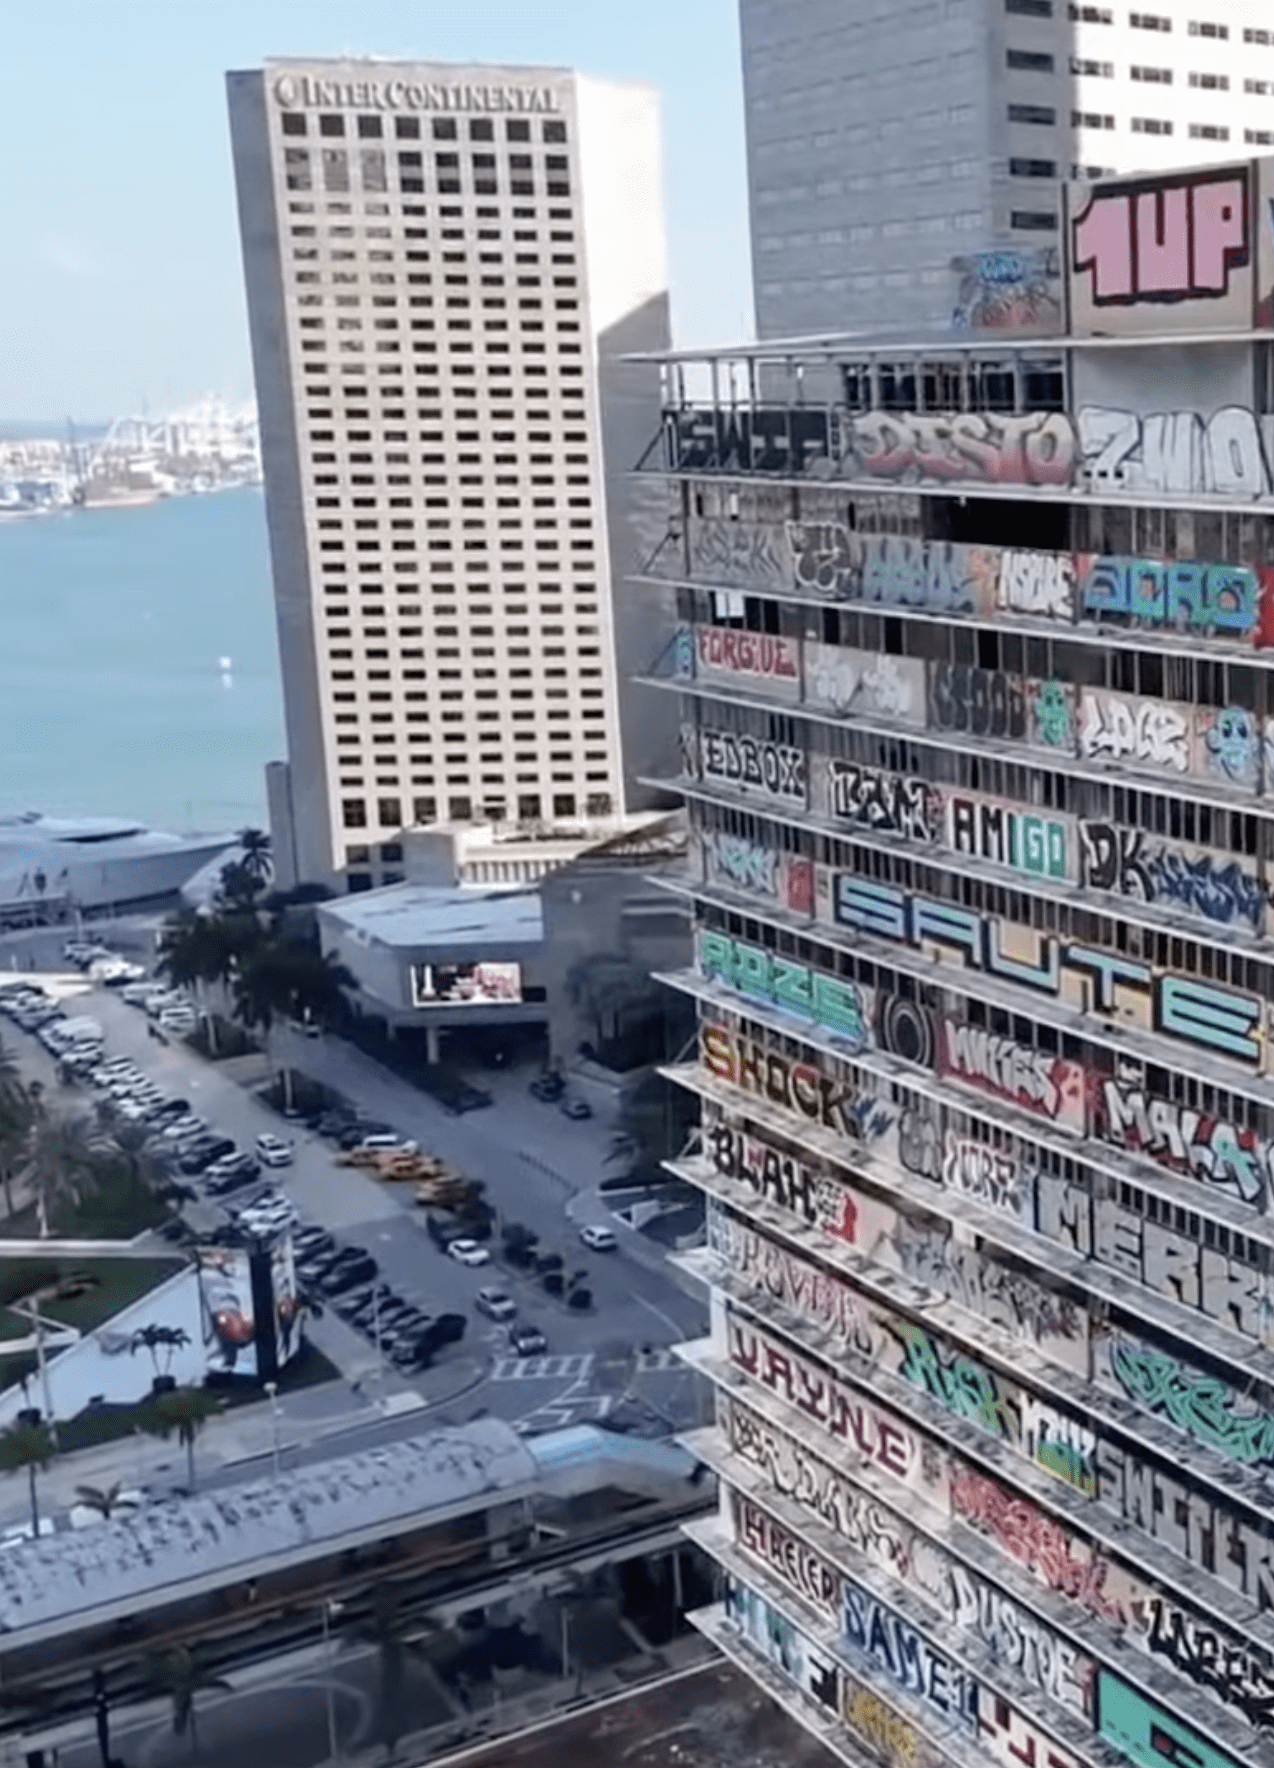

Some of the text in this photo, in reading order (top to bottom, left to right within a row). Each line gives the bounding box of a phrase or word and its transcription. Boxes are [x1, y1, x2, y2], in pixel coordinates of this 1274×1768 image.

[1073, 167, 1250, 305] 1UP
[951, 796, 1066, 879] AMIGO
[701, 1022, 862, 1140] SHOCK
